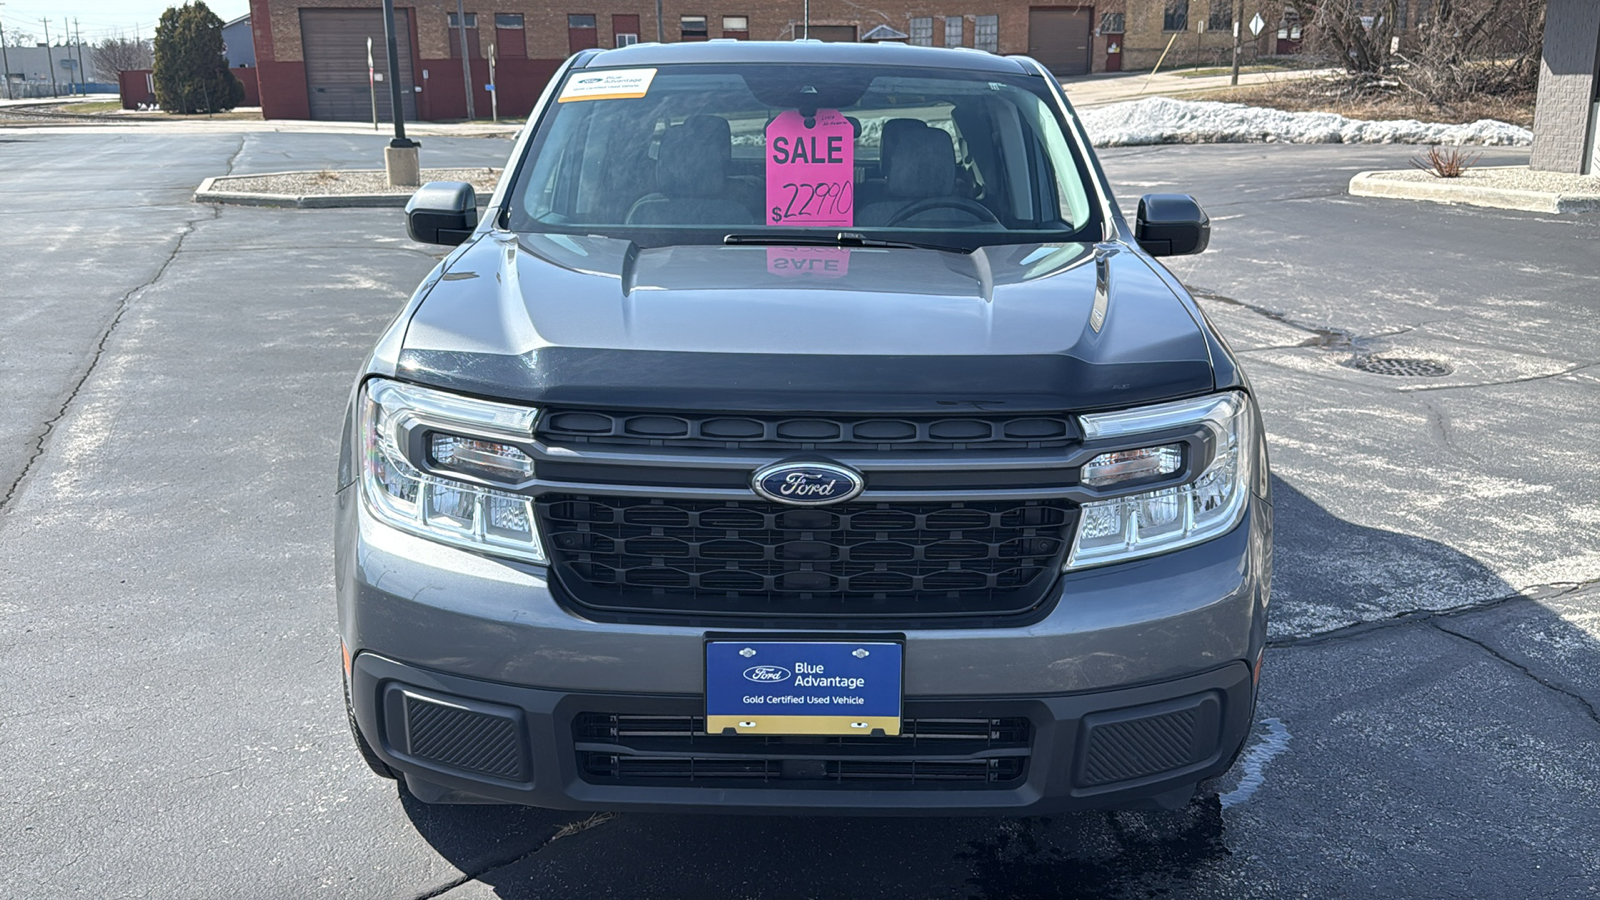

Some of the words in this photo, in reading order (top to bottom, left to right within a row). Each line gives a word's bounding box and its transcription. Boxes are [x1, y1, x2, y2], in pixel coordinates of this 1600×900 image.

[772, 136, 844, 165] SALE
[780, 472, 836, 495] Ford
[752, 667, 782, 680] Ford
[795, 662, 824, 674] Blue
[794, 675, 865, 690] Advantage
[742, 695, 764, 704] Gold
[766, 695, 805, 704] Certified
[806, 696, 830, 704] Used
[832, 696, 865, 705] Vehicle
